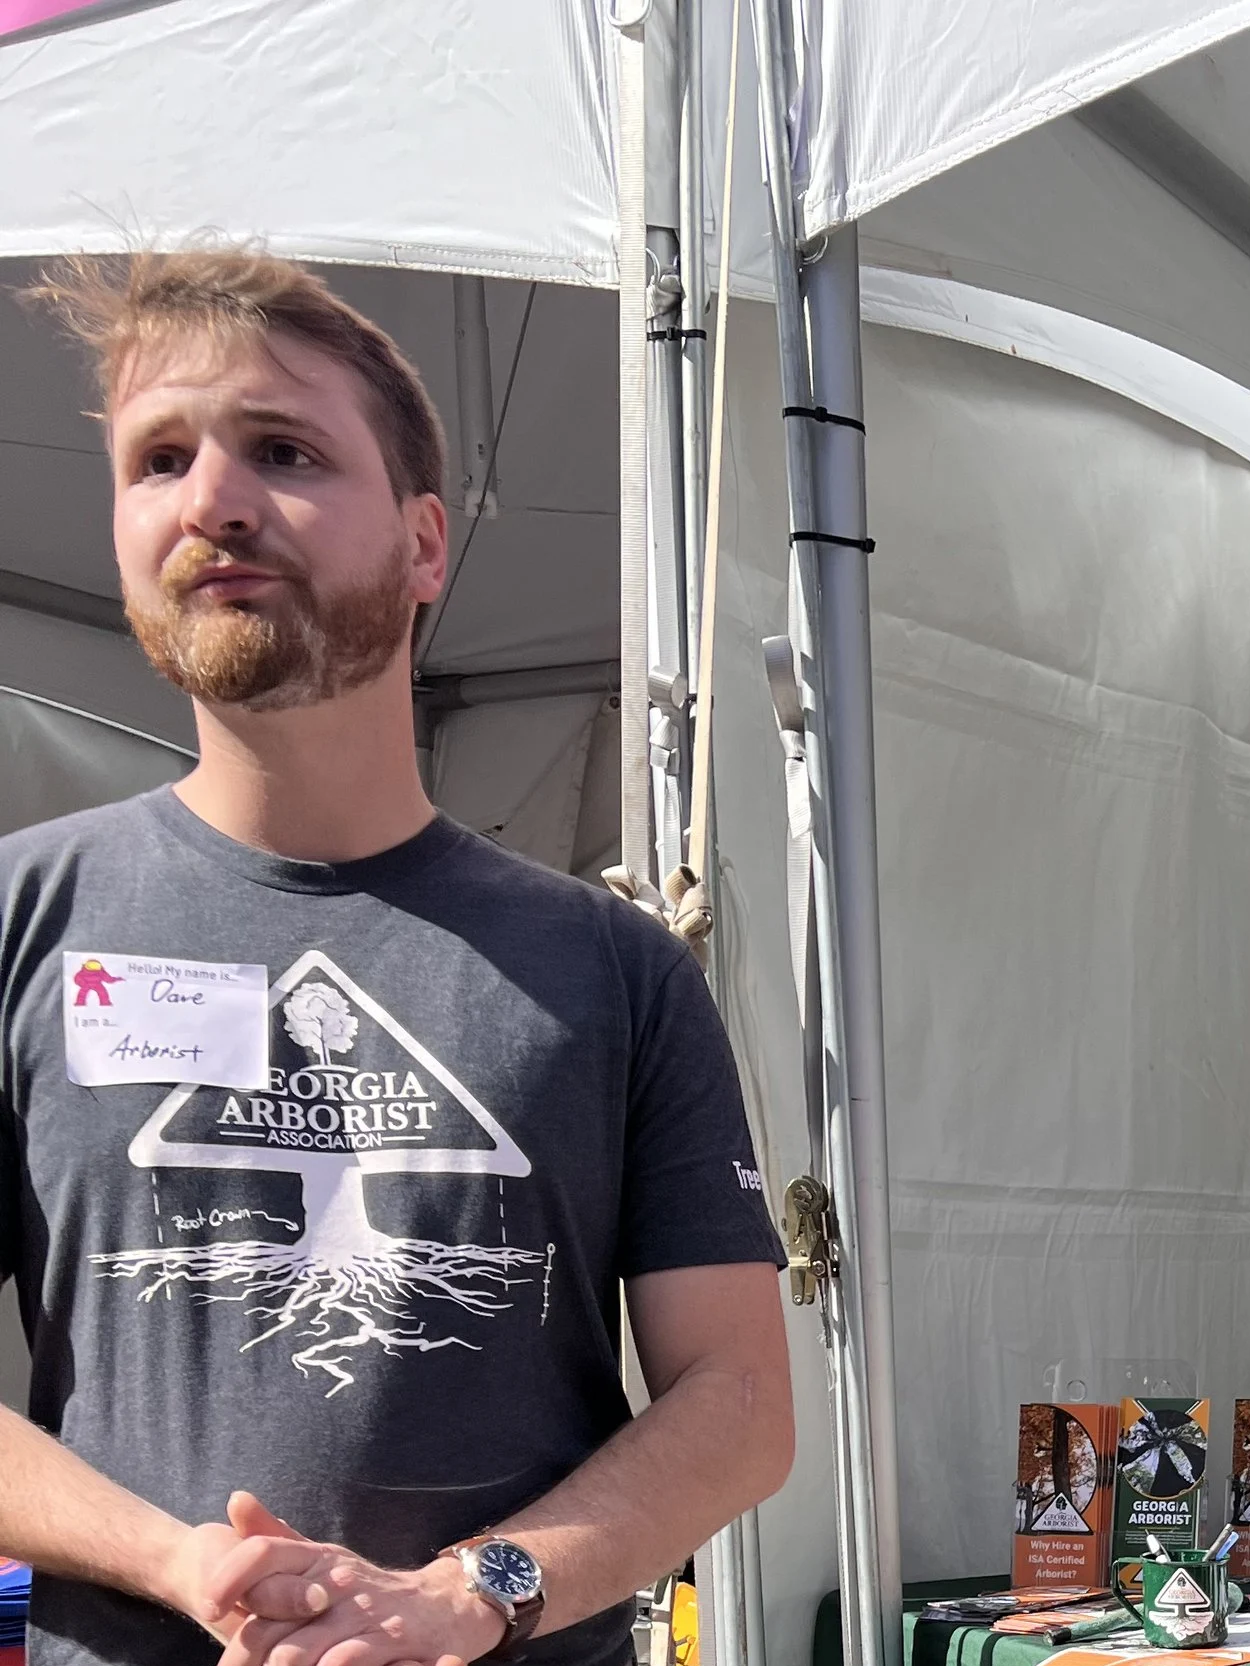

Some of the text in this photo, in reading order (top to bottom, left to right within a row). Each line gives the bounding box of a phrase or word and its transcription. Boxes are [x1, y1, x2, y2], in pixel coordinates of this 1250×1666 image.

[128, 962, 162, 975] Hello!
[165, 965, 182, 979] My
[185, 969, 216, 980] name
[82, 1018, 100, 1028] am
[109, 1034, 203, 1062] Arborist
[235, 1067, 429, 1102] EORGIA
[216, 1095, 437, 1133] ARBORIST
[266, 1129, 383, 1149] ASSOCIATION
[732, 1160, 762, 1191] Tree
[171, 1208, 207, 1232] Root
[1133, 1500, 1189, 1512] GEORGIA
[1044, 1513, 1078, 1521] GEORGIA
[1128, 1512, 1192, 1525] ARBORIST
[1030, 1540, 1050, 1551] Why
[1052, 1541, 1071, 1550] Hire
[1235, 1544, 1249, 1553] ISA
[1028, 1554, 1085, 1565] ISA Certified
[1035, 1568, 1077, 1579] Arborist?
